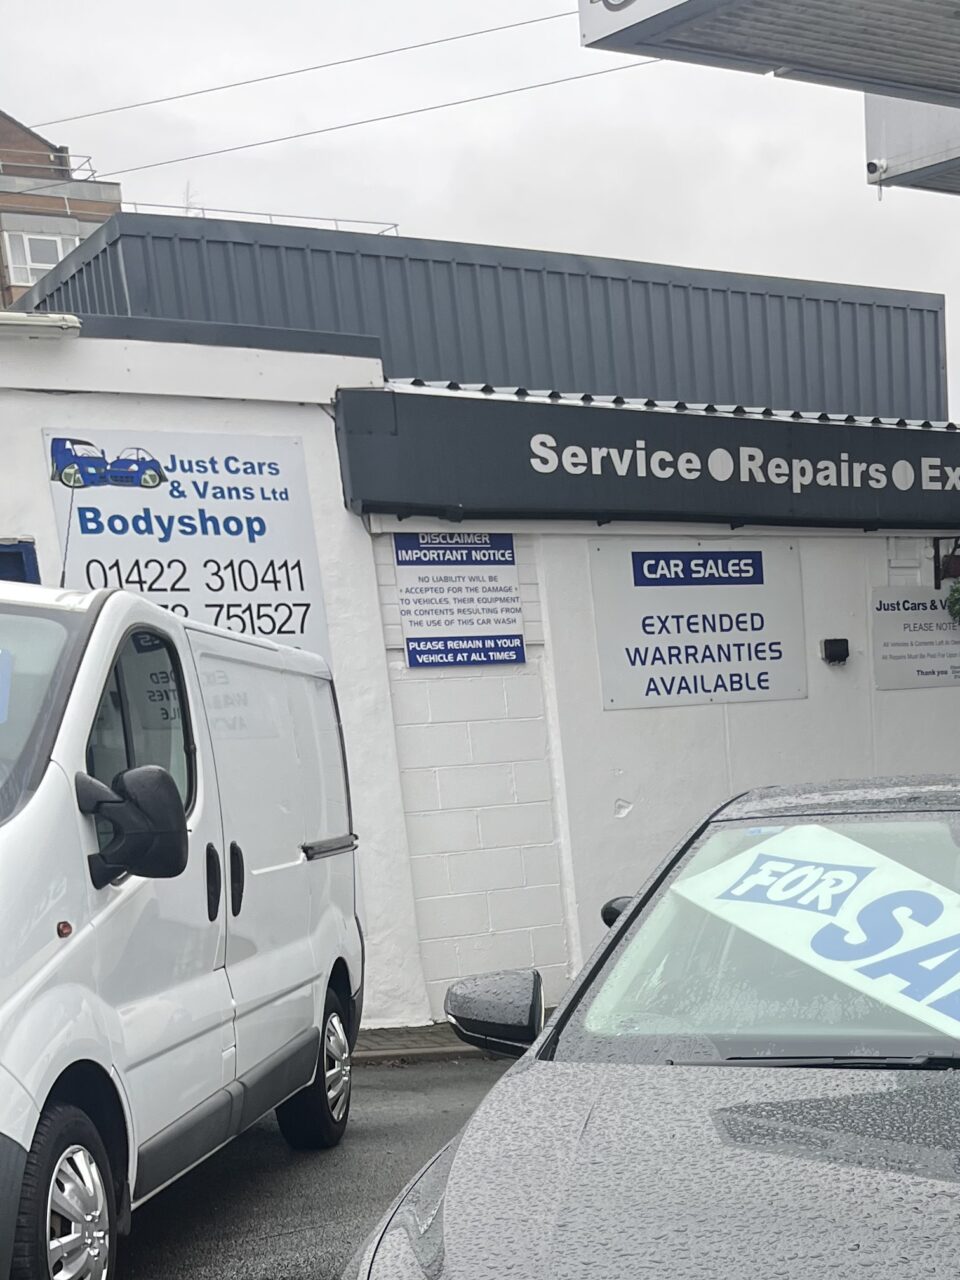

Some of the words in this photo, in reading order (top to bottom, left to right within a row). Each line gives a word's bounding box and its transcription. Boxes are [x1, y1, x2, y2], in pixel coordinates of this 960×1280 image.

[164, 454, 219, 475] Just
[224, 456, 280, 475] Cars
[529, 433, 701, 480] Service
[739, 446, 887, 494] Repairs
[169, 481, 187, 498] &
[192, 481, 255, 501] Vans
[260, 487, 289, 501] Ltd
[77, 506, 267, 543] Bodyshop
[419, 534, 490, 544] DISCLAIMER
[398, 550, 468, 561] IMPORTANT
[472, 549, 513, 561] NOTICE
[86, 559, 190, 592] 01422
[203, 559, 305, 592] 310411
[488, 575, 498, 583] BE
[643, 559, 684, 579] CAR
[691, 559, 754, 577] SALES
[876, 600, 900, 611] Just
[902, 600, 928, 611] Cars
[929, 600, 938, 610] &
[205, 603, 311, 635] 751527
[641, 613, 765, 635] EXTENDED
[903, 622, 934, 632] PLEASE
[936, 622, 958, 631] NOTE
[409, 642, 445, 650] PLEASE
[447, 641, 483, 649] REMAIN
[485, 640, 494, 648] IN
[496, 639, 521, 647] YOUR
[625, 642, 783, 667] WARRANTIES
[416, 655, 454, 663] VEHICLE
[456, 654, 468, 662] AT
[471, 653, 486, 661] ALL
[489, 652, 516, 660] TIMES
[645, 672, 770, 697] AVAILABLE
[731, 860, 858, 911] FOR
